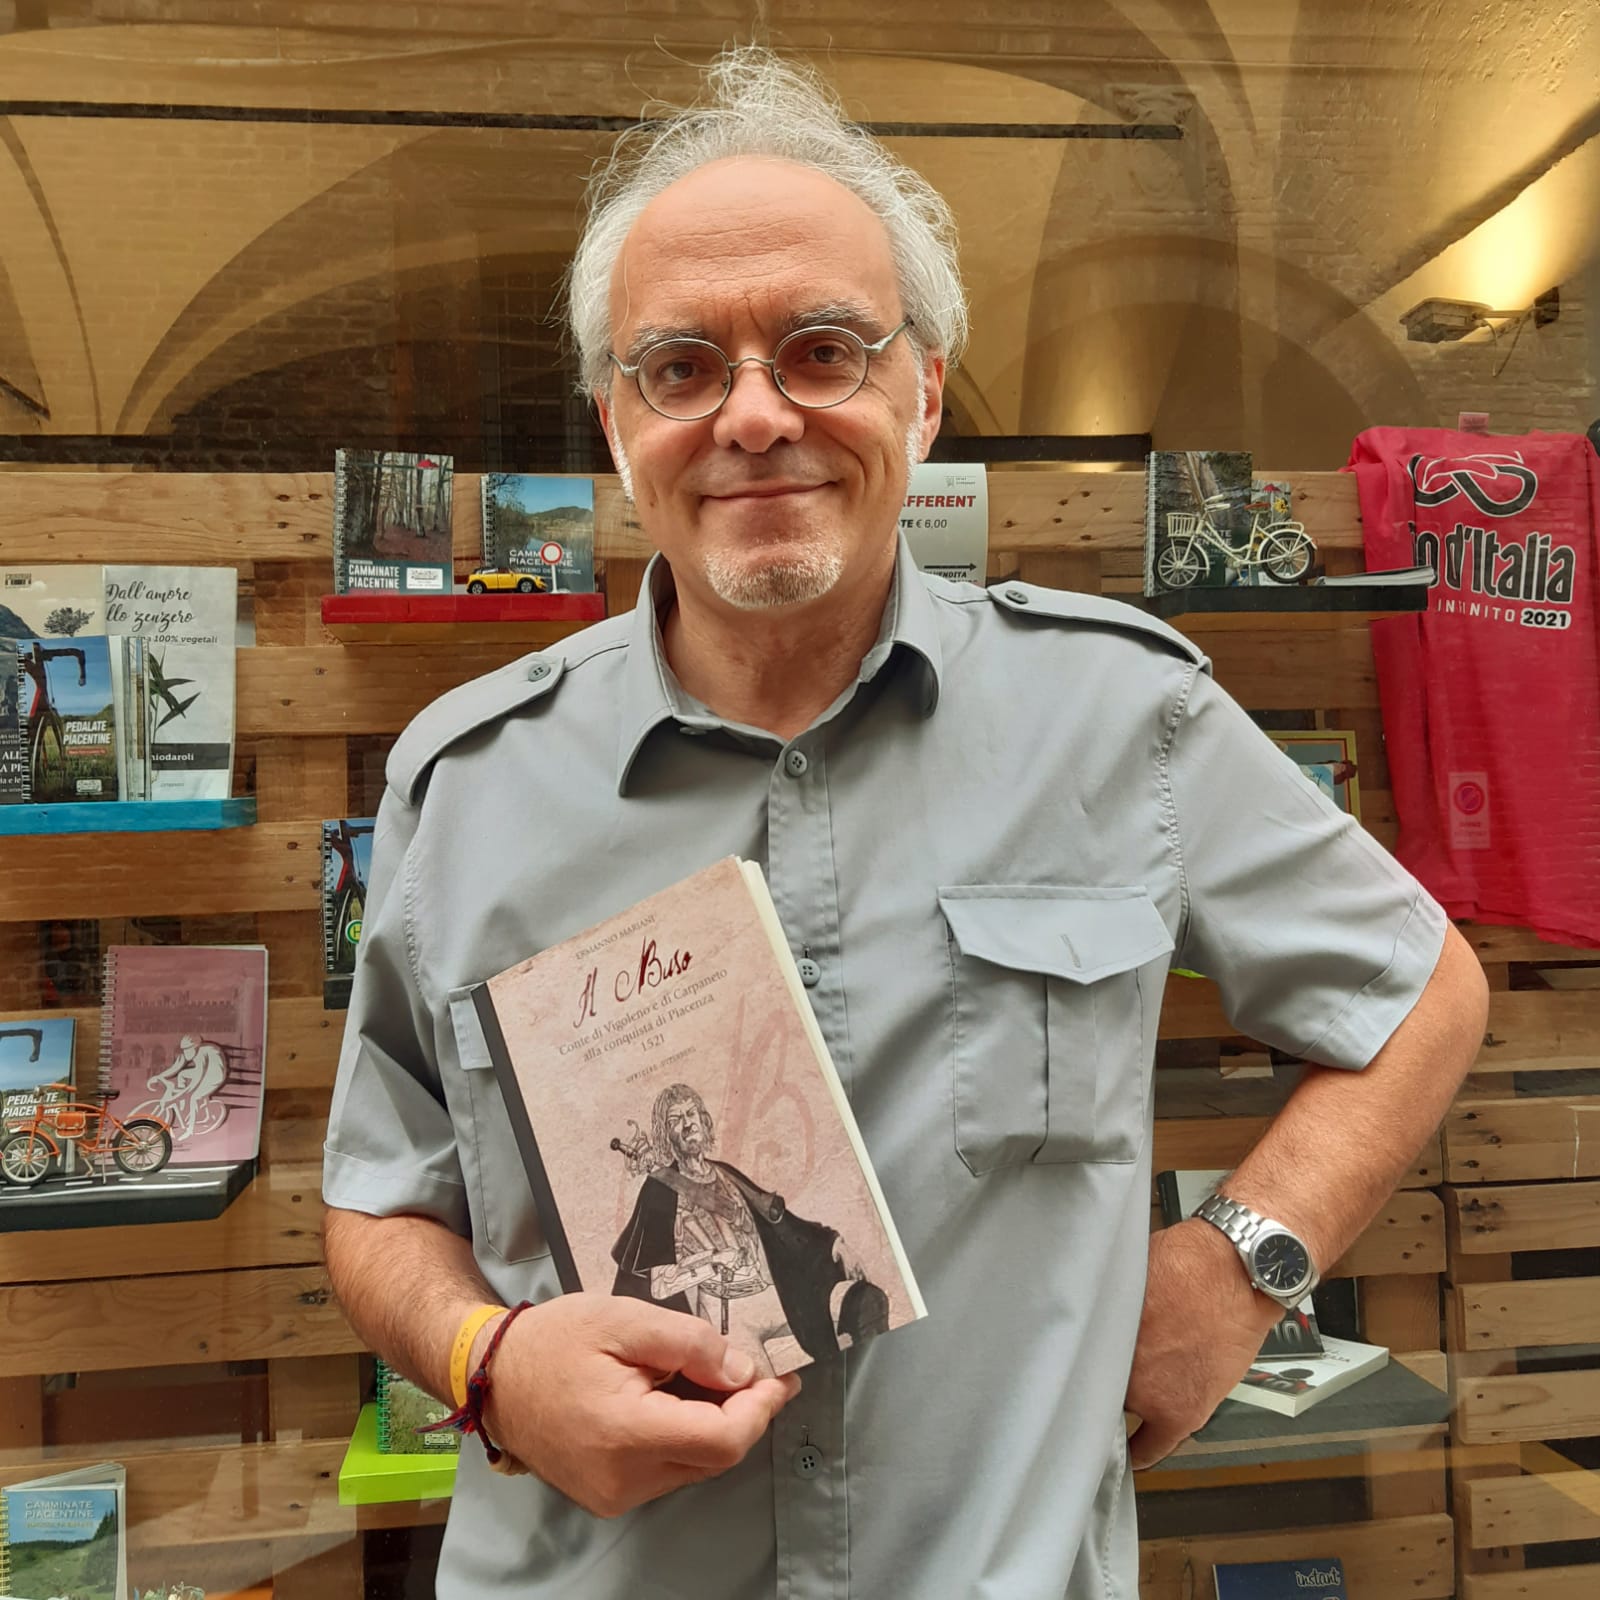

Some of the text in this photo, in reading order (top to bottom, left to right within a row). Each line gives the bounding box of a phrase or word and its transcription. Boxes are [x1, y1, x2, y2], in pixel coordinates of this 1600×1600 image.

[348, 564, 400, 577] CAMMINATE
[1445, 523, 1576, 604] d'Italia
[348, 576, 400, 589] PIACENTINE
[105, 580, 192, 604] Dall'amore
[131, 610, 195, 633] zenzero
[1522, 610, 1568, 628] 2021
[153, 634, 179, 643] 100%
[181, 635, 218, 645] vegetali
[65, 720, 107, 732] PEDALATE
[62, 732, 112, 745] PIACENTINE
[615, 936, 693, 1002] Buso
[559, 968, 728, 1057] Conte di Vigoleno e di Carpaneto
[583, 993, 715, 1062] alla conquista di Piacenza
[640, 1034, 665, 1051] 1521
[25, 1501, 94, 1510] CAMMINATE
[25, 1510, 95, 1520] PIACENTINE
[1295, 1567, 1341, 1587] instant
